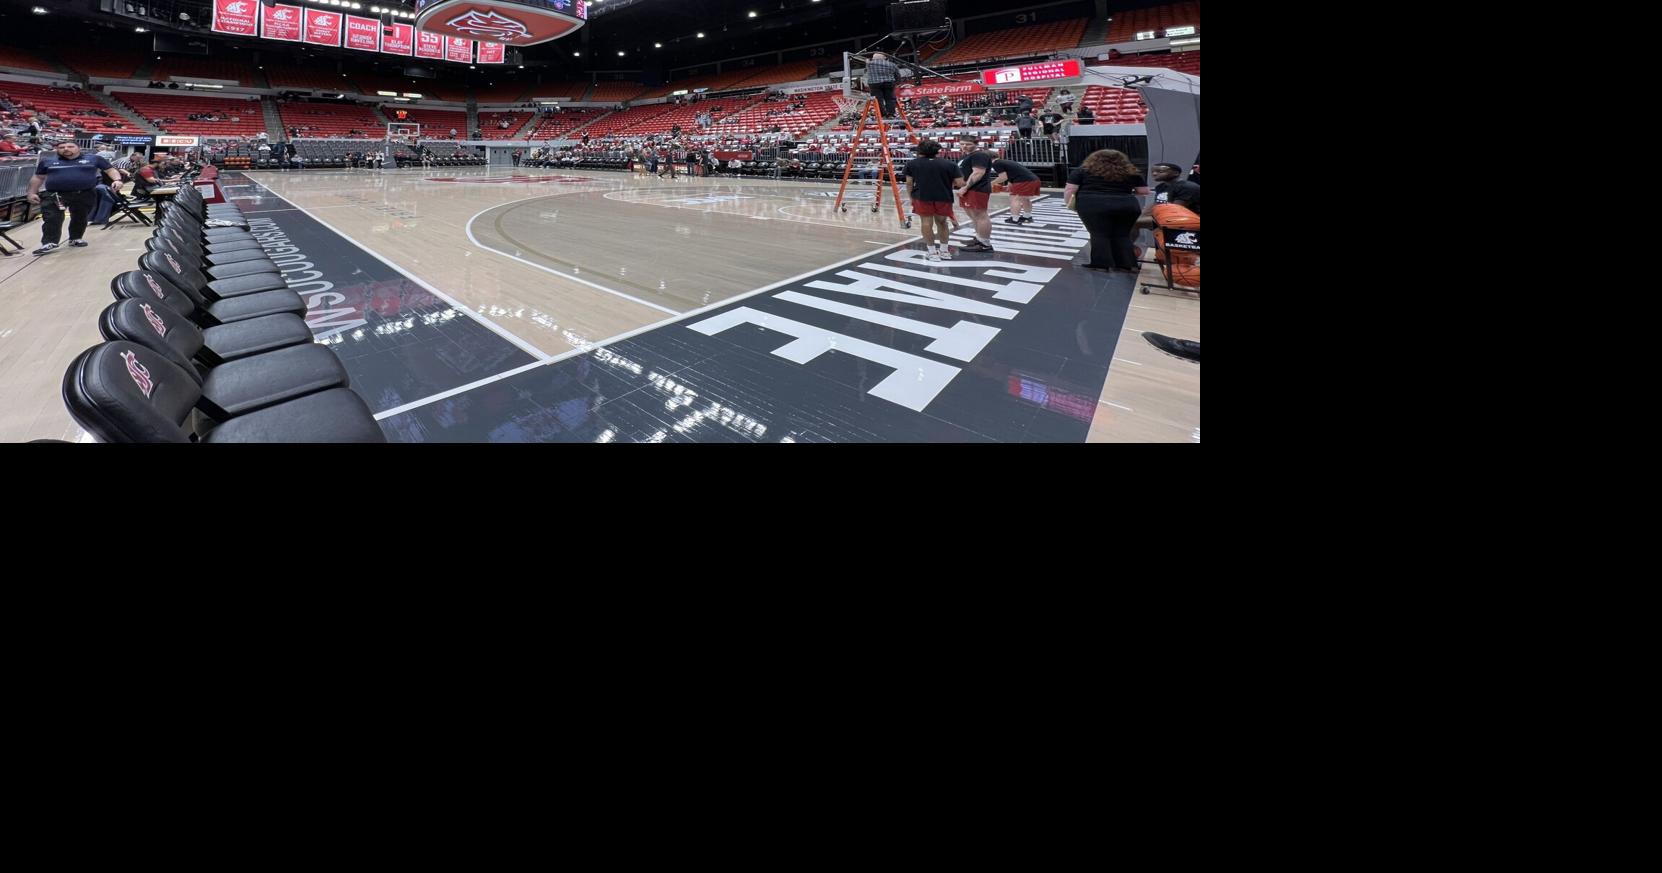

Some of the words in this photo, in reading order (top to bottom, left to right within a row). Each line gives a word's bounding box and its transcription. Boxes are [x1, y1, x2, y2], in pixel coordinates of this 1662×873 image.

[1015, 11, 1037, 24] 31
[349, 22, 377, 32] COACH
[395, 26, 401, 39] 1
[421, 31, 438, 43] 55
[1022, 63, 1064, 71] PULLMAN
[1022, 68, 1065, 76] REGIONAL
[1004, 73, 1014, 81] P
[1023, 73, 1065, 81] HOSPITAL
[686, 248, 1063, 412] STATE
